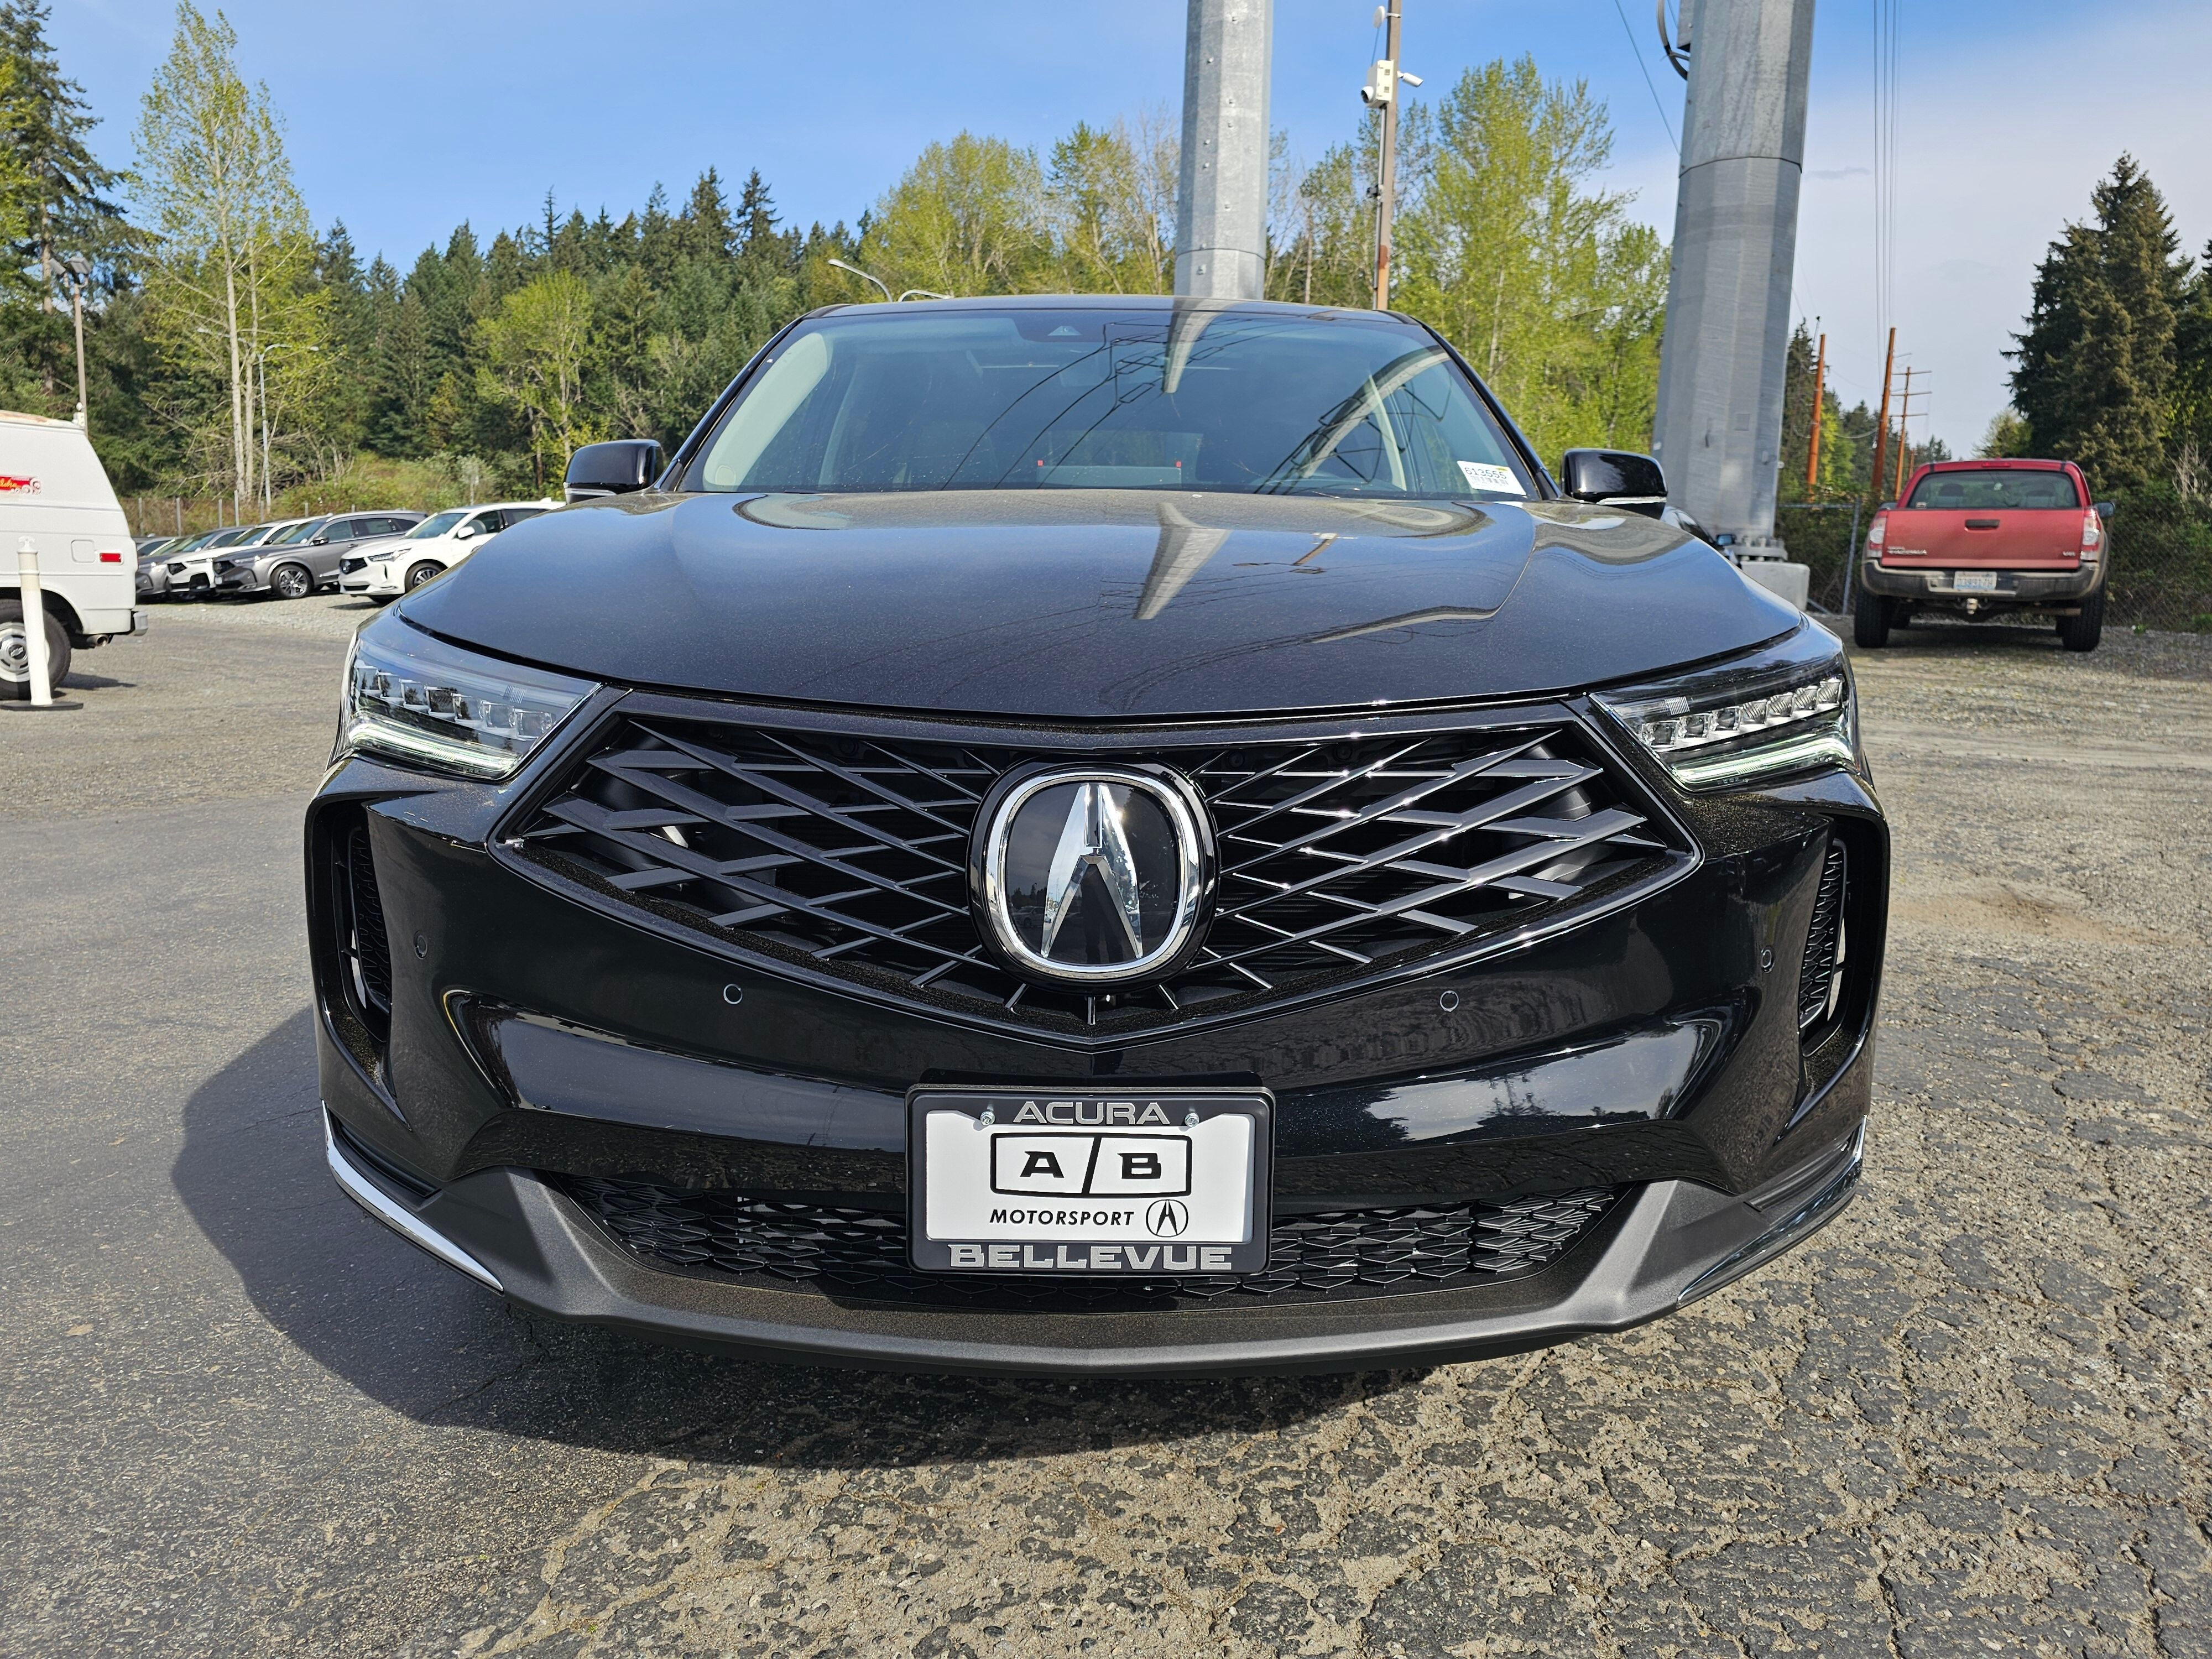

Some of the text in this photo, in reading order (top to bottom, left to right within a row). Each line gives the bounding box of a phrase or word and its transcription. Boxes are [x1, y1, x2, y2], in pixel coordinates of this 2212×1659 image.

[1013, 1100, 1170, 1125] ACURA
[989, 1209, 1135, 1226] MOTORSPORT
[947, 1244, 1232, 1270] BELLEVUE
